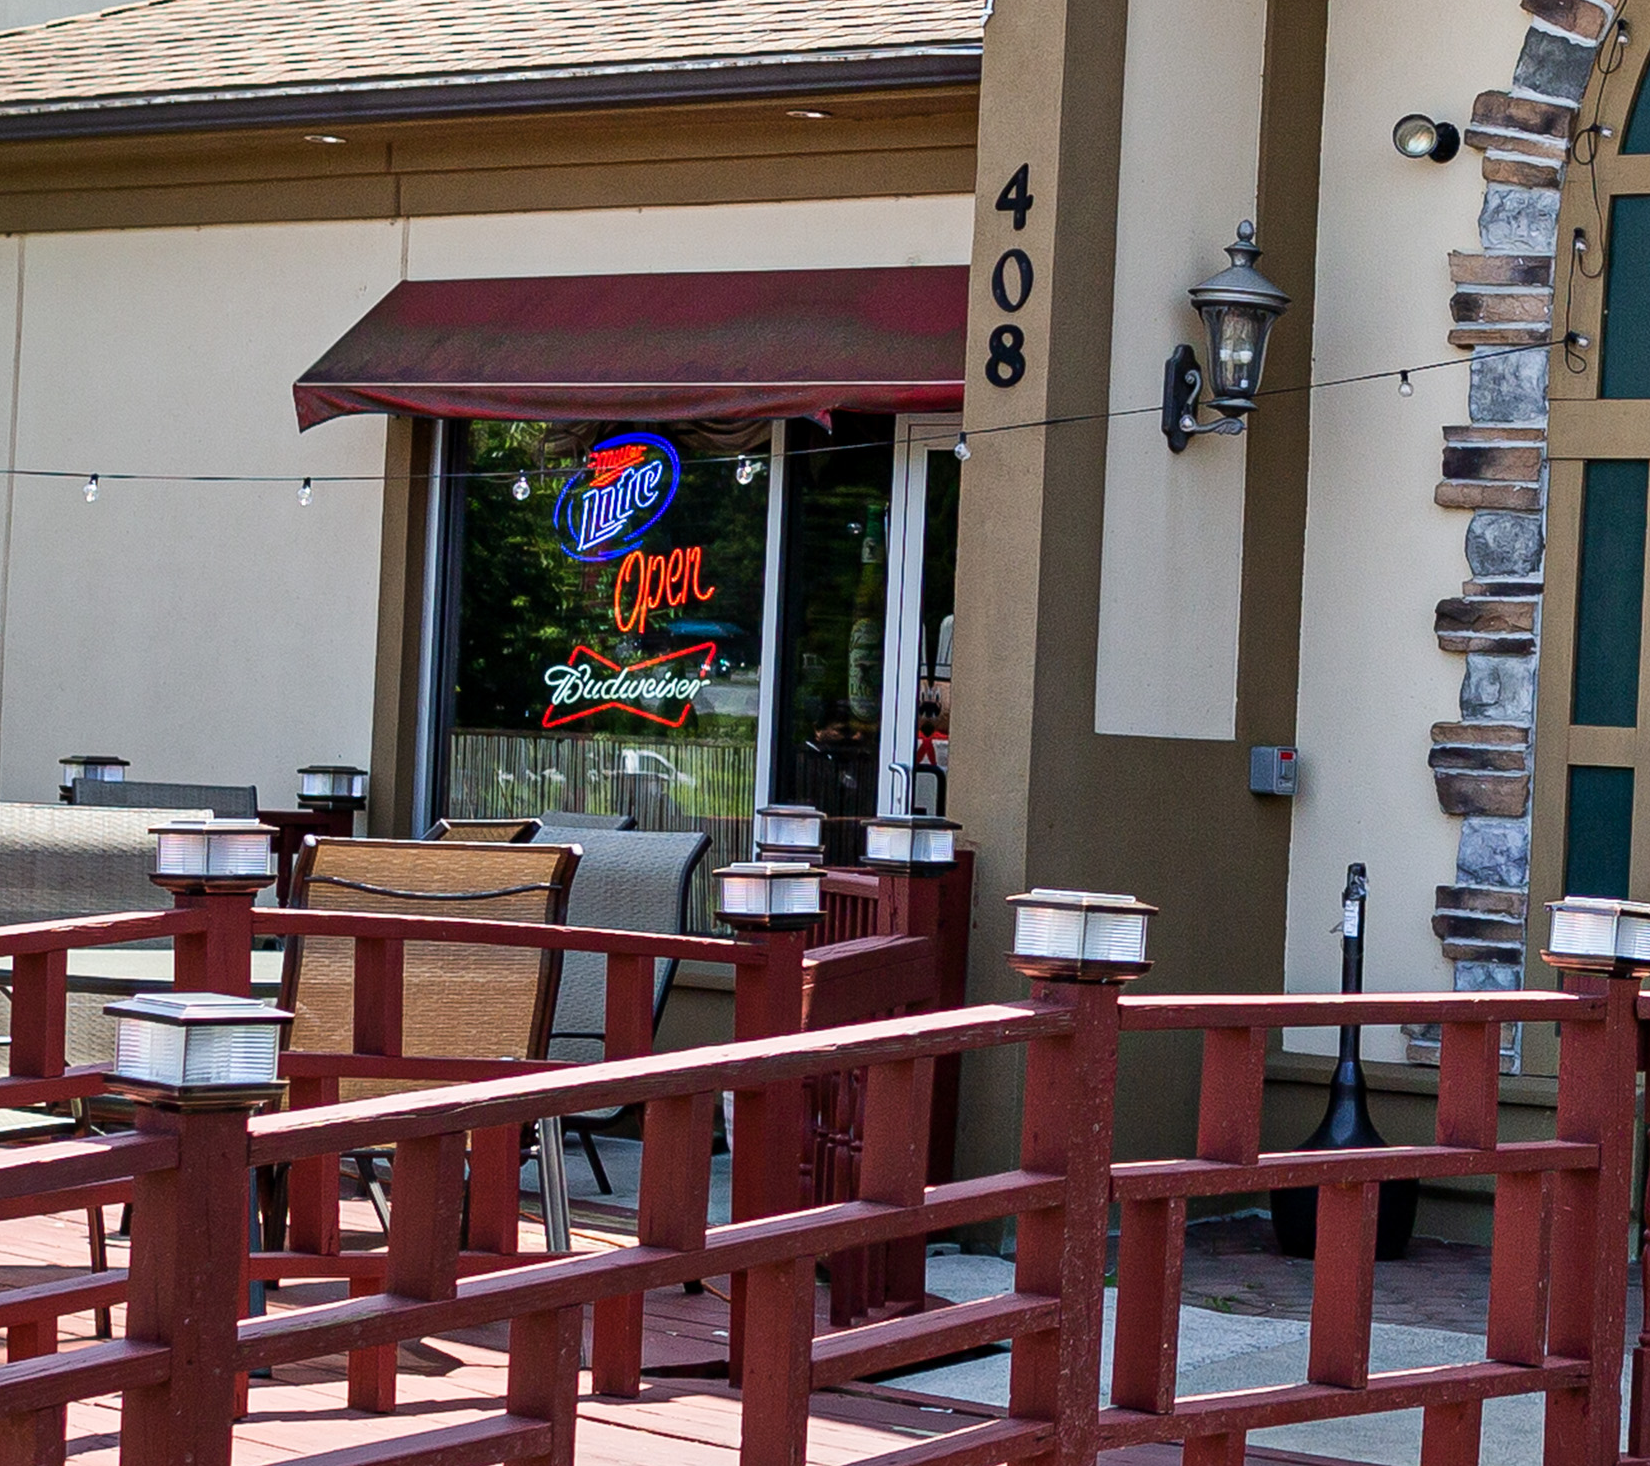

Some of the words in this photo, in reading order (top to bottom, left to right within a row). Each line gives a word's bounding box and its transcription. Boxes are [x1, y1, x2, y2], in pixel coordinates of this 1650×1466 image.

[985, 162, 1034, 389] 408
[614, 546, 715, 634] Open
[544, 663, 711, 705] Budweiser
